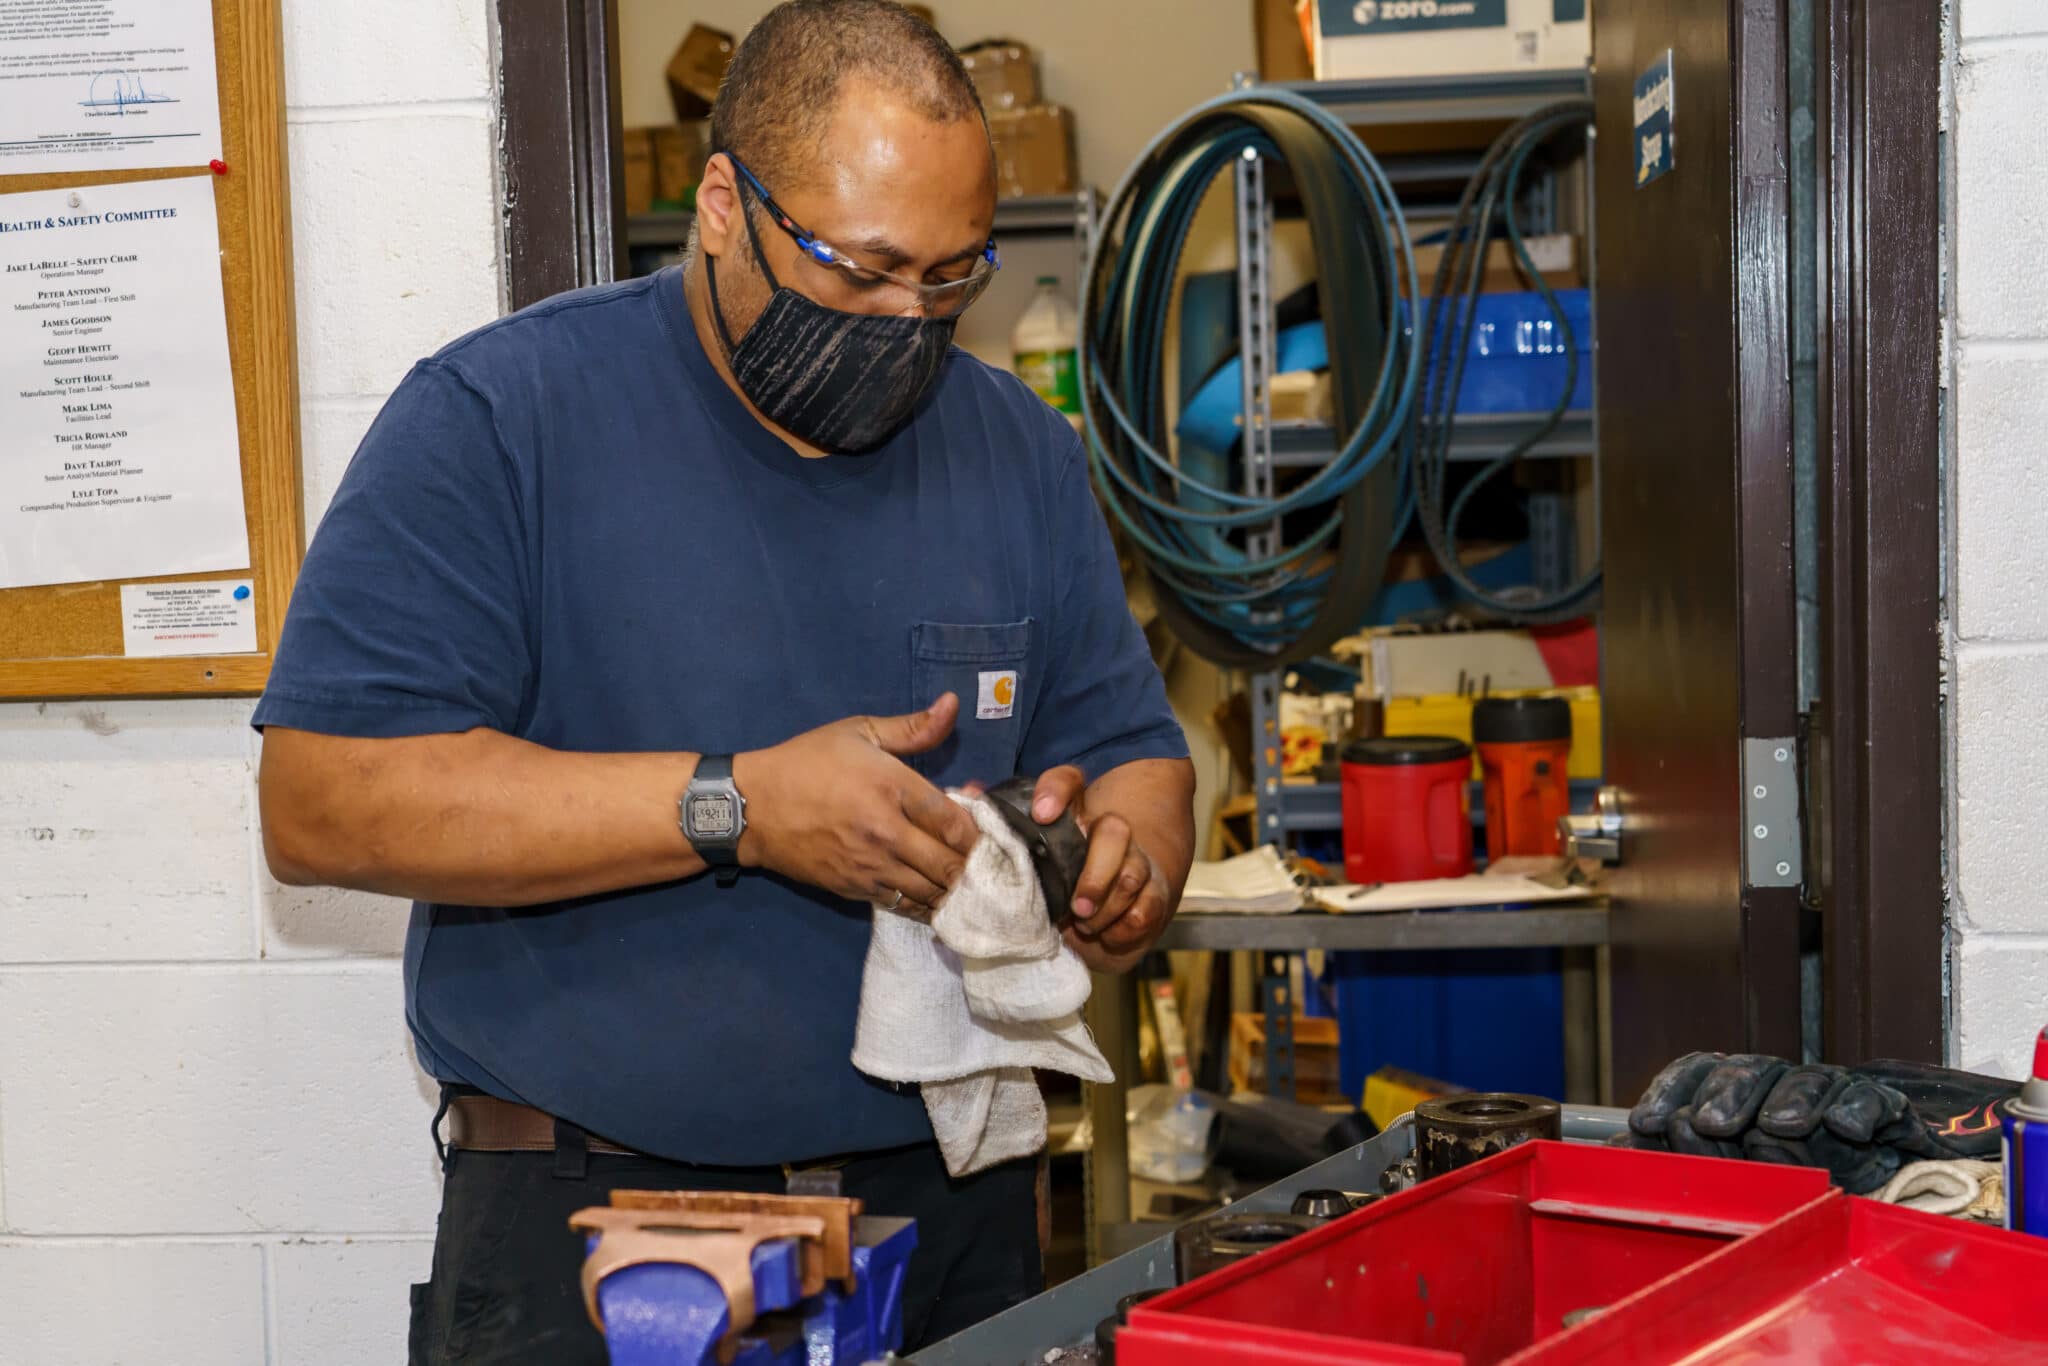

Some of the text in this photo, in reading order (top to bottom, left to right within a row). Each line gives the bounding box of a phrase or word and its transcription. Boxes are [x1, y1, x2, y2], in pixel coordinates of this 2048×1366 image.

[44, 218, 55, 229] &
[58, 215, 101, 227] SAFETY
[104, 208, 177, 223] COMMITTEE
[6, 264, 27, 272] JAKE
[76, 257, 108, 266] SAFETY
[110, 254, 137, 263] CHAIR
[40, 268, 104, 280] Operations Manager
[37, 287, 110, 300] PETER ANTONINO
[14, 302, 61, 311] Manufacturing
[41, 315, 112, 328] JAMES GOODSON
[74, 327, 102, 335] Engineer
[47, 344, 111, 356] GEOFF HEWITT
[43, 354, 119, 366] Maintenance Electrician
[54, 376, 81, 385] SCOTT
[19, 389, 66, 398] Manufacturing
[86, 384, 103, 392] Lead
[109, 382, 133, 390] Second
[62, 403, 113, 413] MARK LIMA
[65, 414, 94, 423] Facilities
[54, 430, 127, 443] TRICIA ROWLAND
[84, 442, 112, 451] Manager
[64, 462, 88, 471] DAVE
[96, 488, 119, 497] TOPA
[65, 500, 100, 508] Production
[143, 494, 172, 503] Engineer
